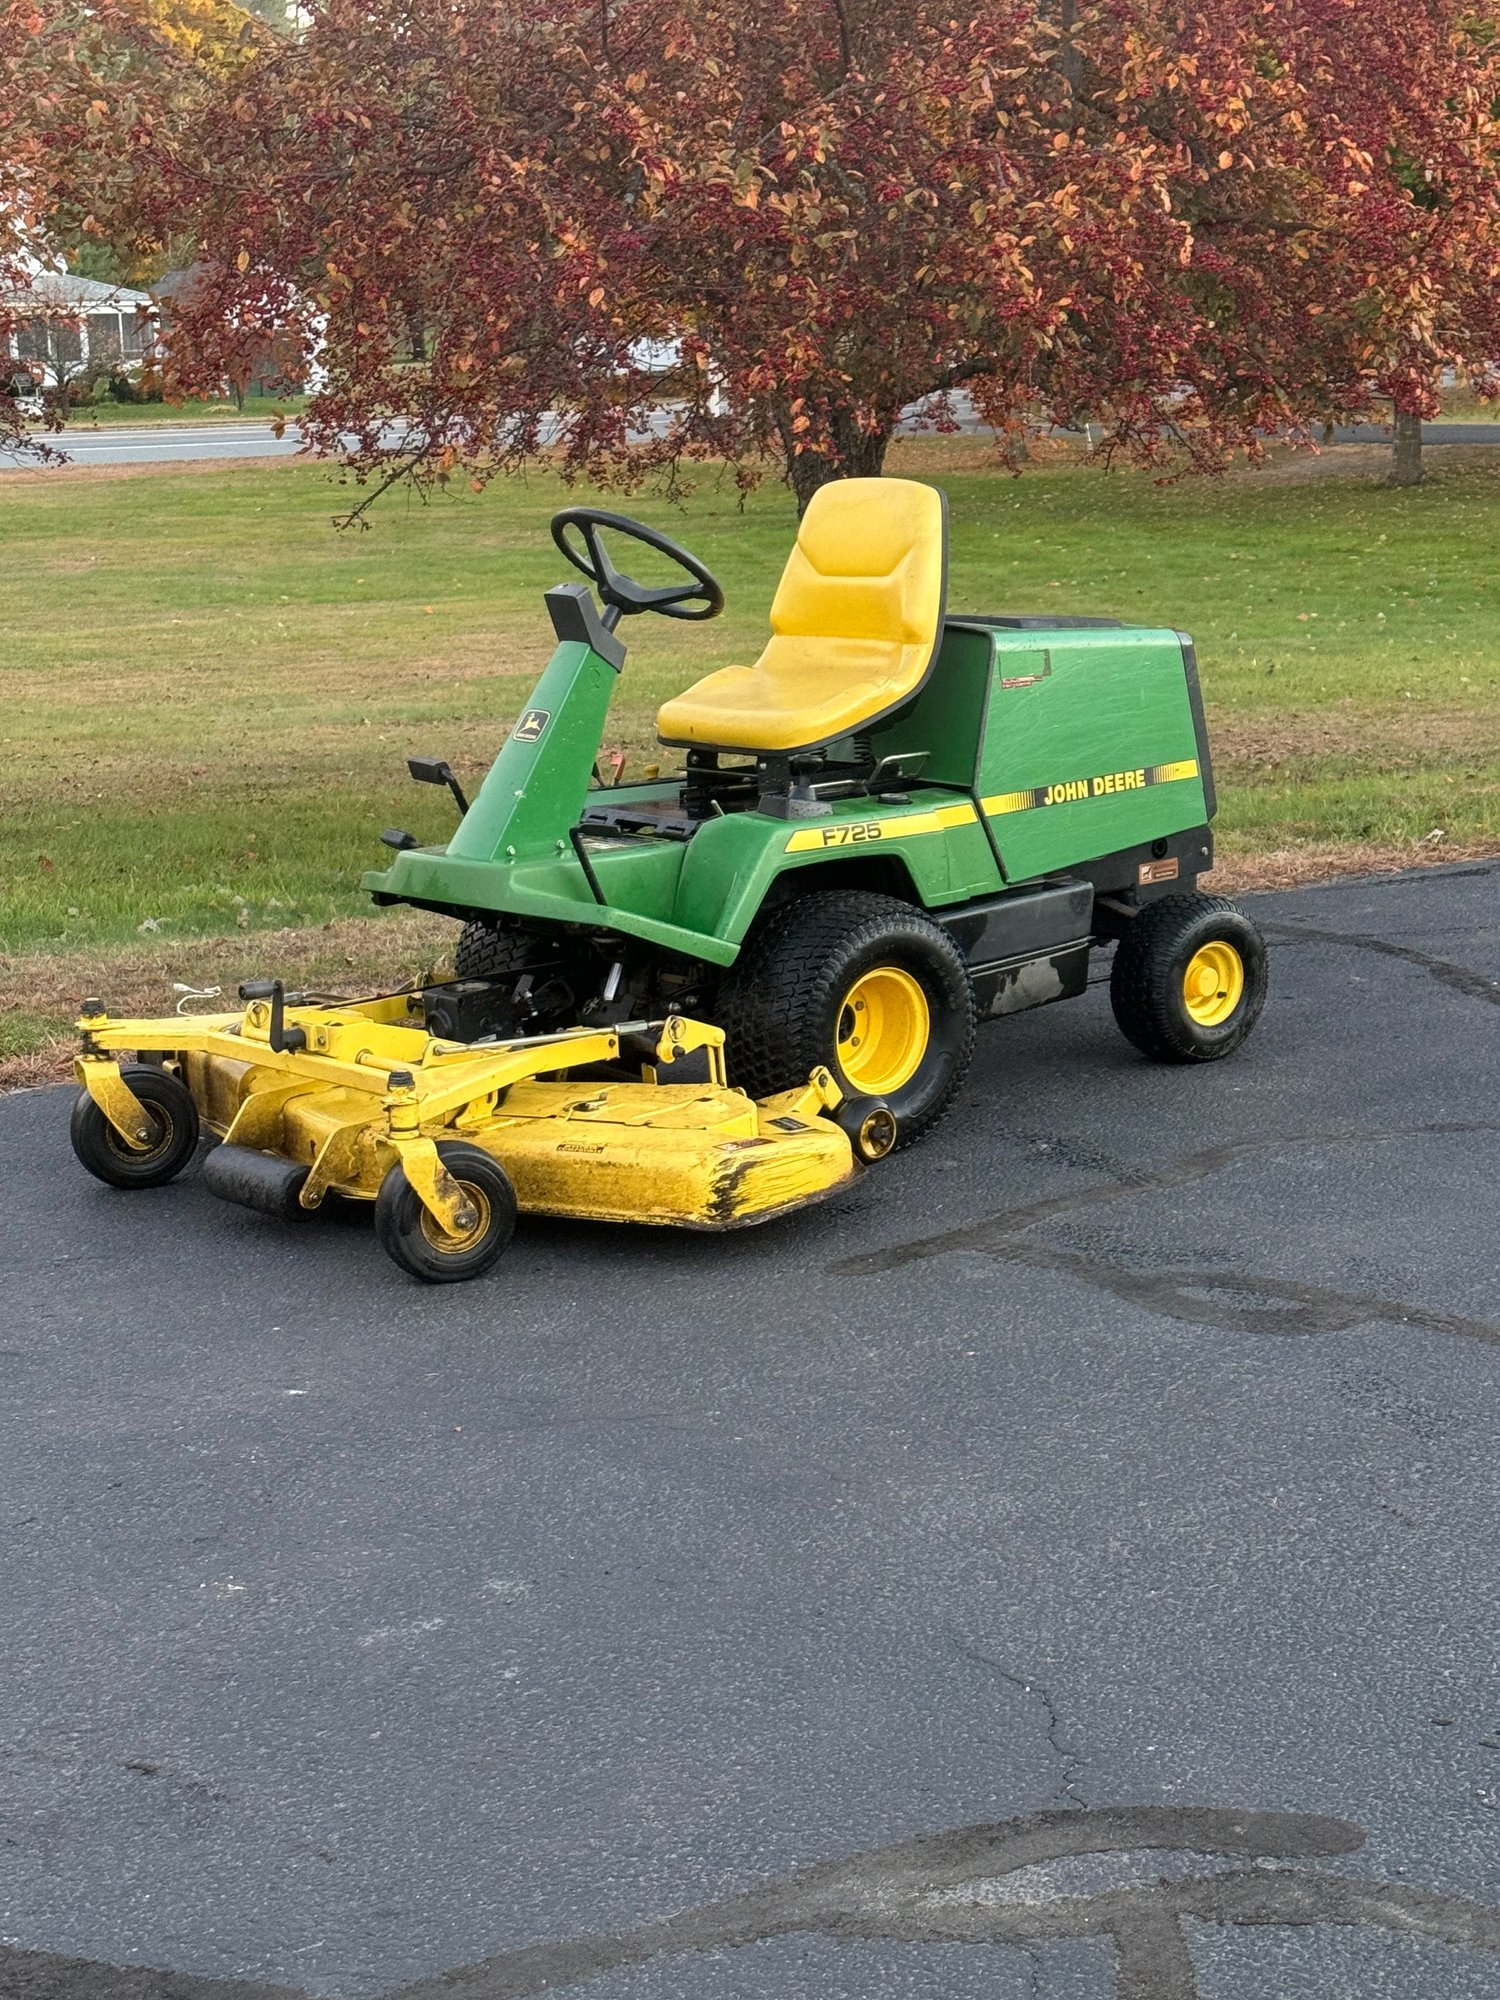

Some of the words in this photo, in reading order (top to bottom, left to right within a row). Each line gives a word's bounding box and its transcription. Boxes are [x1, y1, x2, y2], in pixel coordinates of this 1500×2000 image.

[1044, 780, 1089, 806] JOHN
[1093, 769, 1146, 796] DEERE
[822, 822, 882, 845] F725
